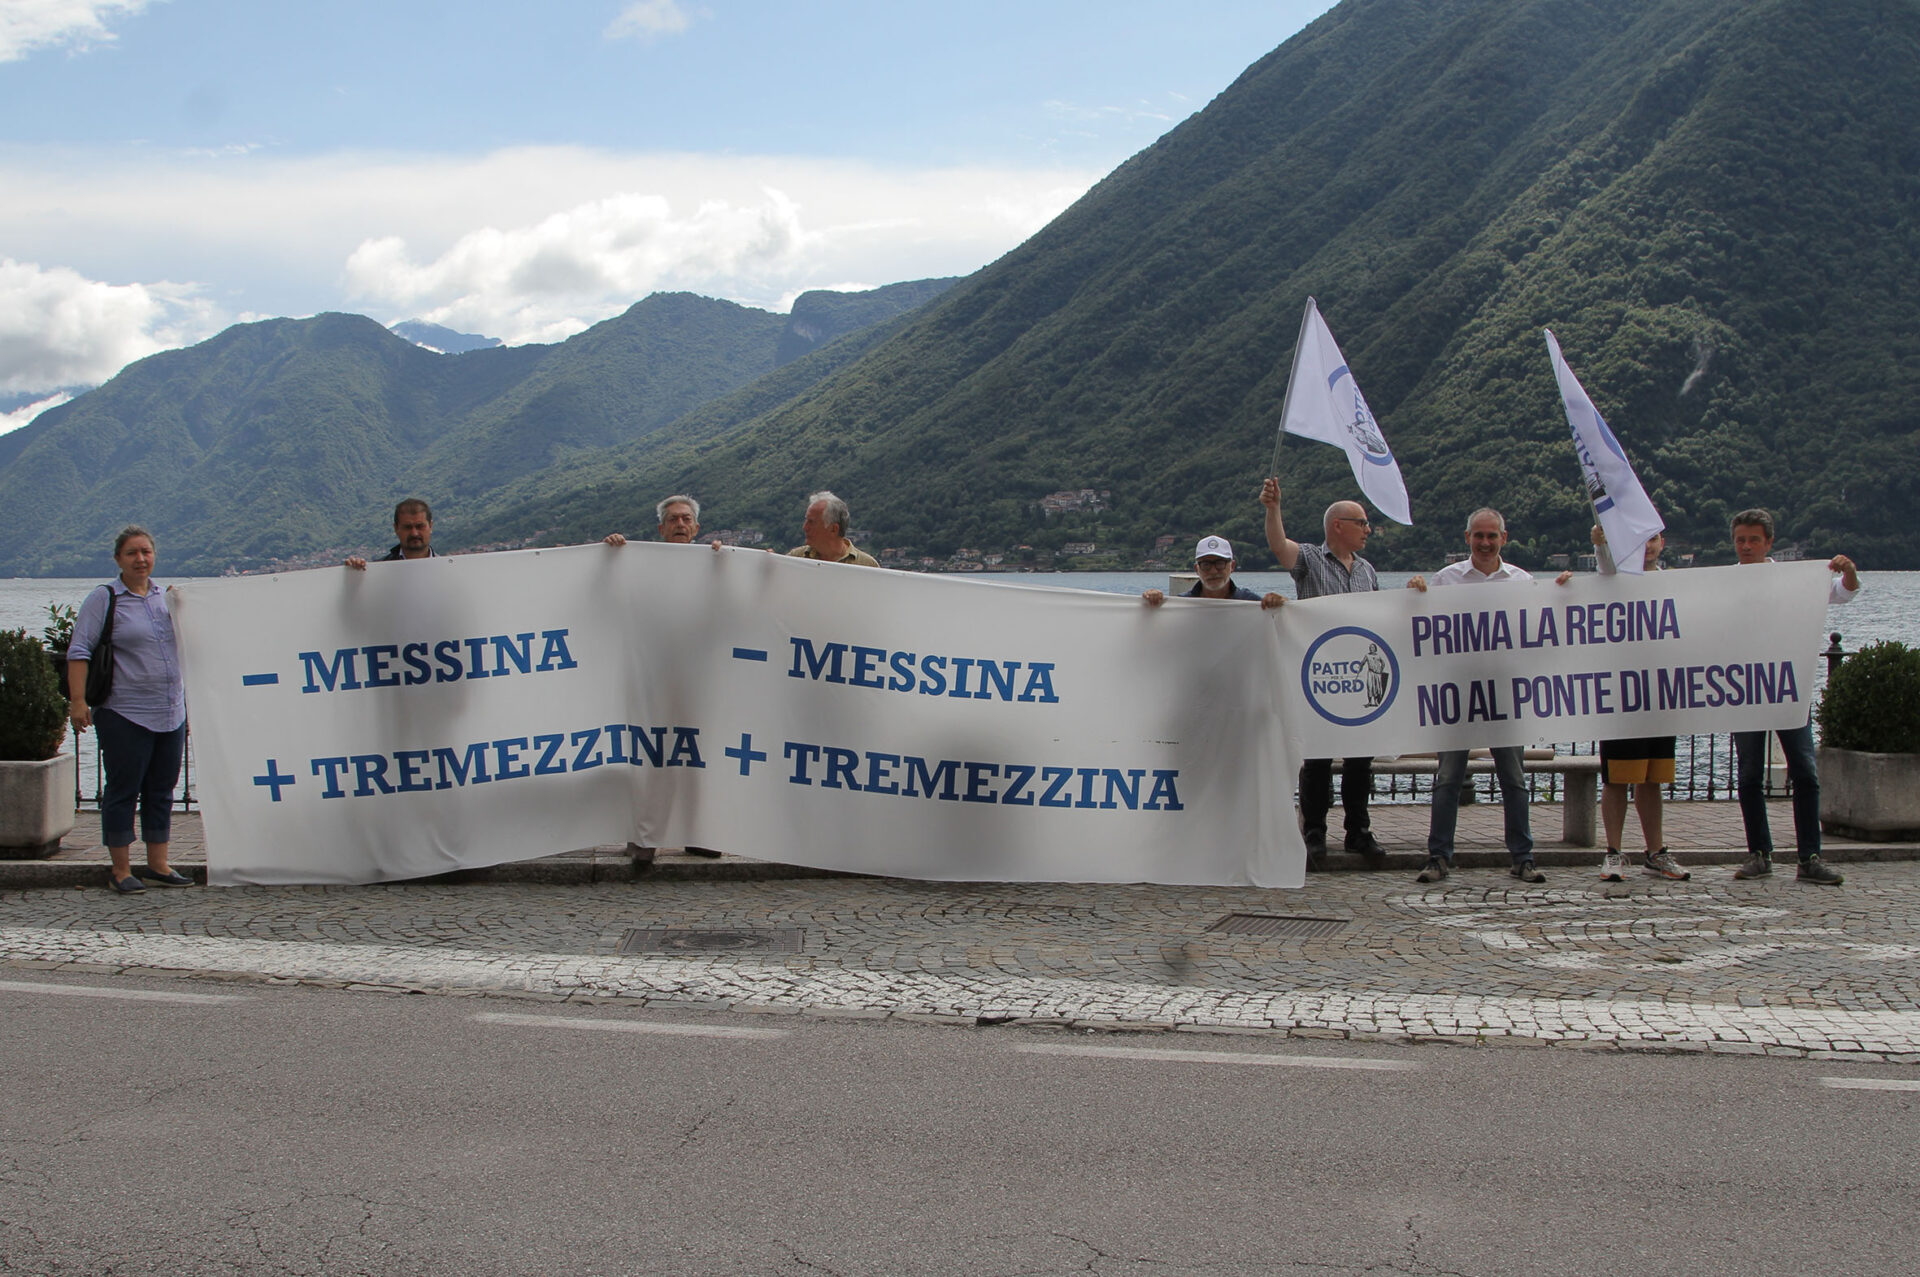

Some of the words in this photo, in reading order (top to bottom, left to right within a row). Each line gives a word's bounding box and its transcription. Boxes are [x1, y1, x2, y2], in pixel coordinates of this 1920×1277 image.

[1412, 610, 1513, 657] PRIMA
[1520, 607, 1559, 648] LA
[1566, 599, 1680, 646] REGINA
[298, 629, 577, 693] MESSINA
[789, 637, 1059, 703] MESSINA
[1312, 660, 1363, 675] PATTO
[1313, 680, 1364, 694] NORD
[1417, 682, 1461, 726] NO
[1468, 679, 1508, 722] AL
[1512, 672, 1614, 719] PONTE
[1619, 669, 1650, 712] DI
[1657, 661, 1799, 710] MESSINA
[310, 724, 706, 799] TREMEZZINA
[784, 742, 1184, 810] TREMEZZINA
